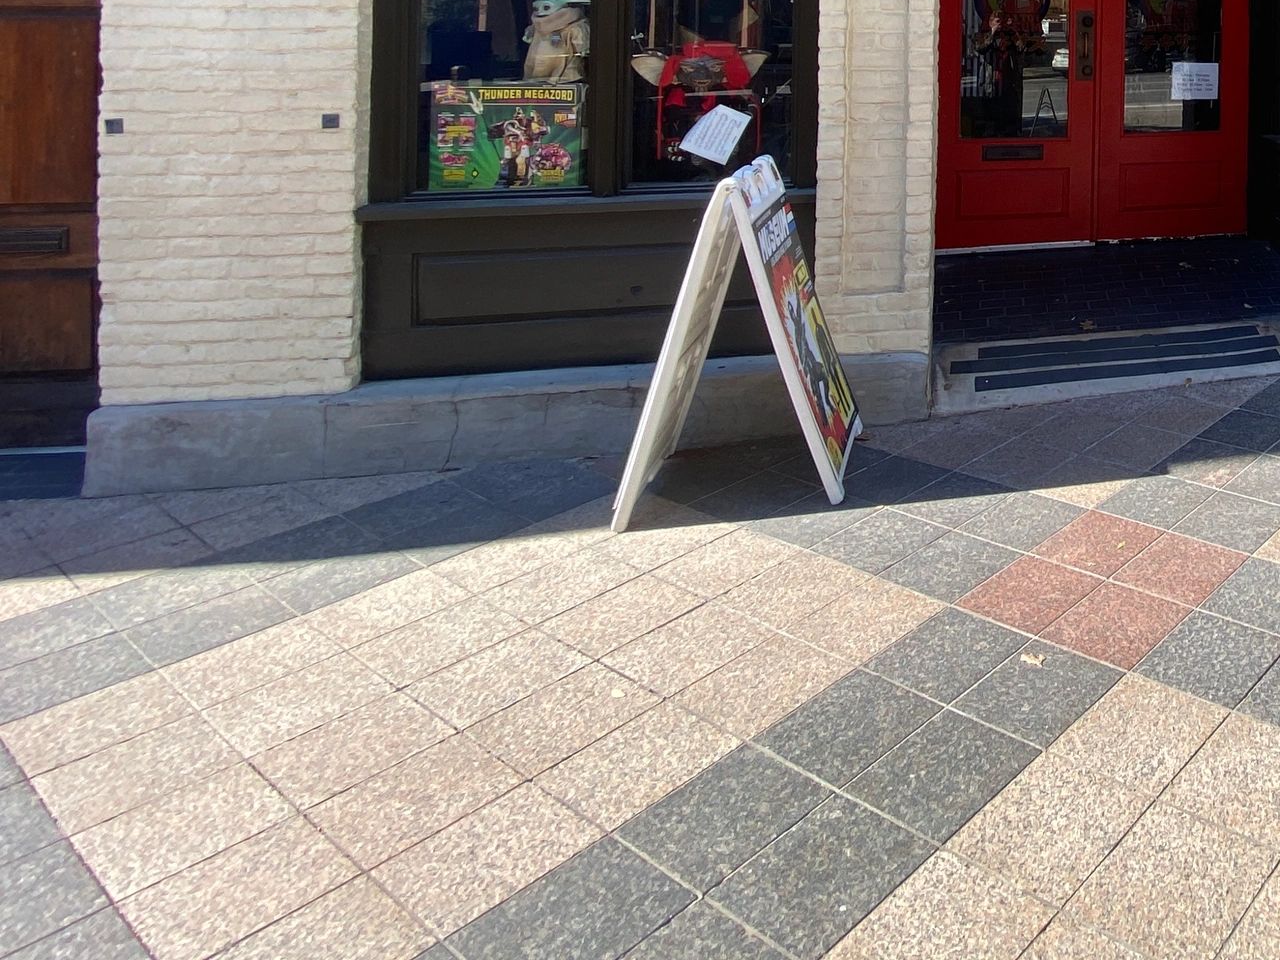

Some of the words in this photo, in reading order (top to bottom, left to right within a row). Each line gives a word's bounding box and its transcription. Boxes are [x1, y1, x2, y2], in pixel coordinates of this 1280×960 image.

[478, 89, 522, 101] THUNDER
[524, 89, 573, 101] MEGAZORD
[757, 206, 790, 265] MUSEUM
